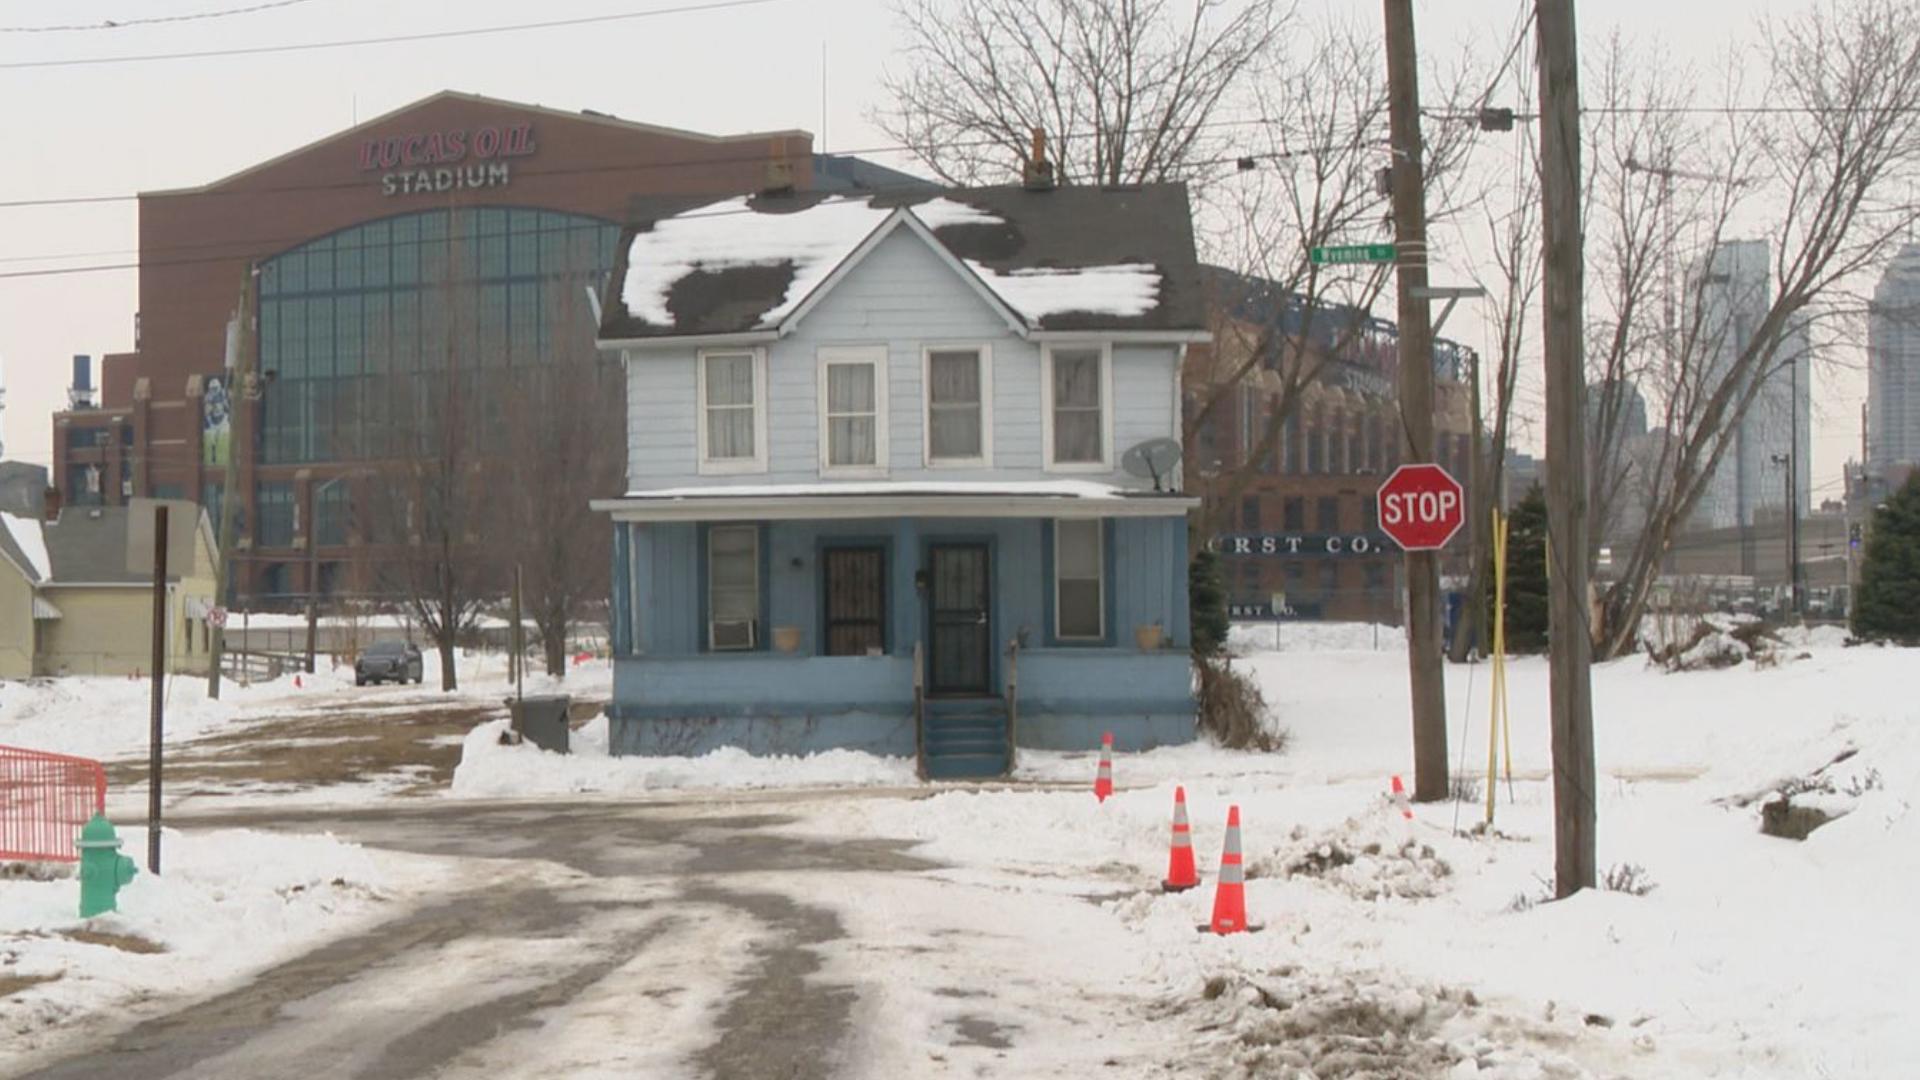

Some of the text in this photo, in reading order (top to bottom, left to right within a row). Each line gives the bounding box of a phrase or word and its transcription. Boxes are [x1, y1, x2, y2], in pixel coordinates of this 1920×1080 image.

[358, 121, 537, 170] LUCAS OIL
[382, 162, 509, 196] STADIUM
[1385, 490, 1457, 524] STOP
[1325, 536, 1381, 553] CO.
